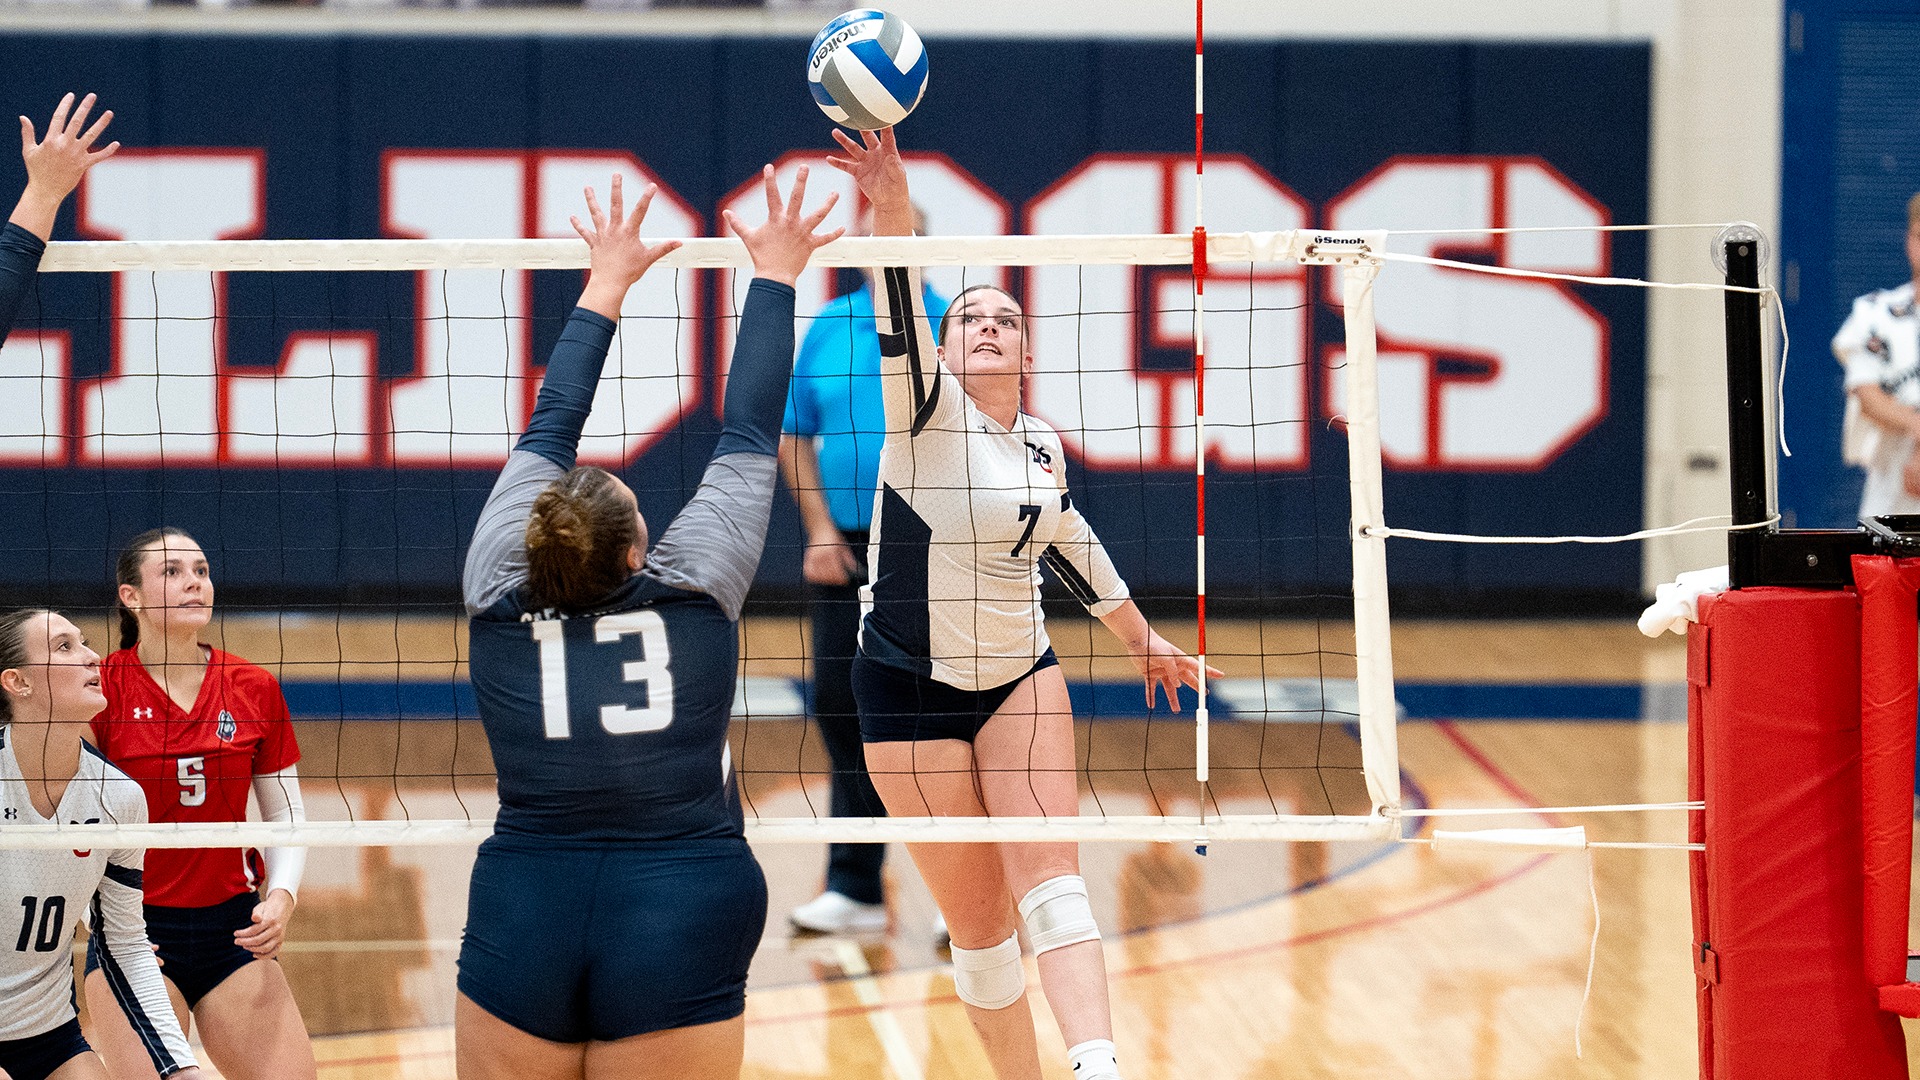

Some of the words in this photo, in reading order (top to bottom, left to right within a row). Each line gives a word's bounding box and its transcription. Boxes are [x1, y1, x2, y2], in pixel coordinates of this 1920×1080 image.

[1323, 236, 1365, 244] Senoh
[0, 148, 1612, 472] LDOGS
[1011, 504, 1042, 557] 7
[532, 610, 674, 739] 13
[177, 756, 206, 807] 5
[15, 895, 66, 953] 10
